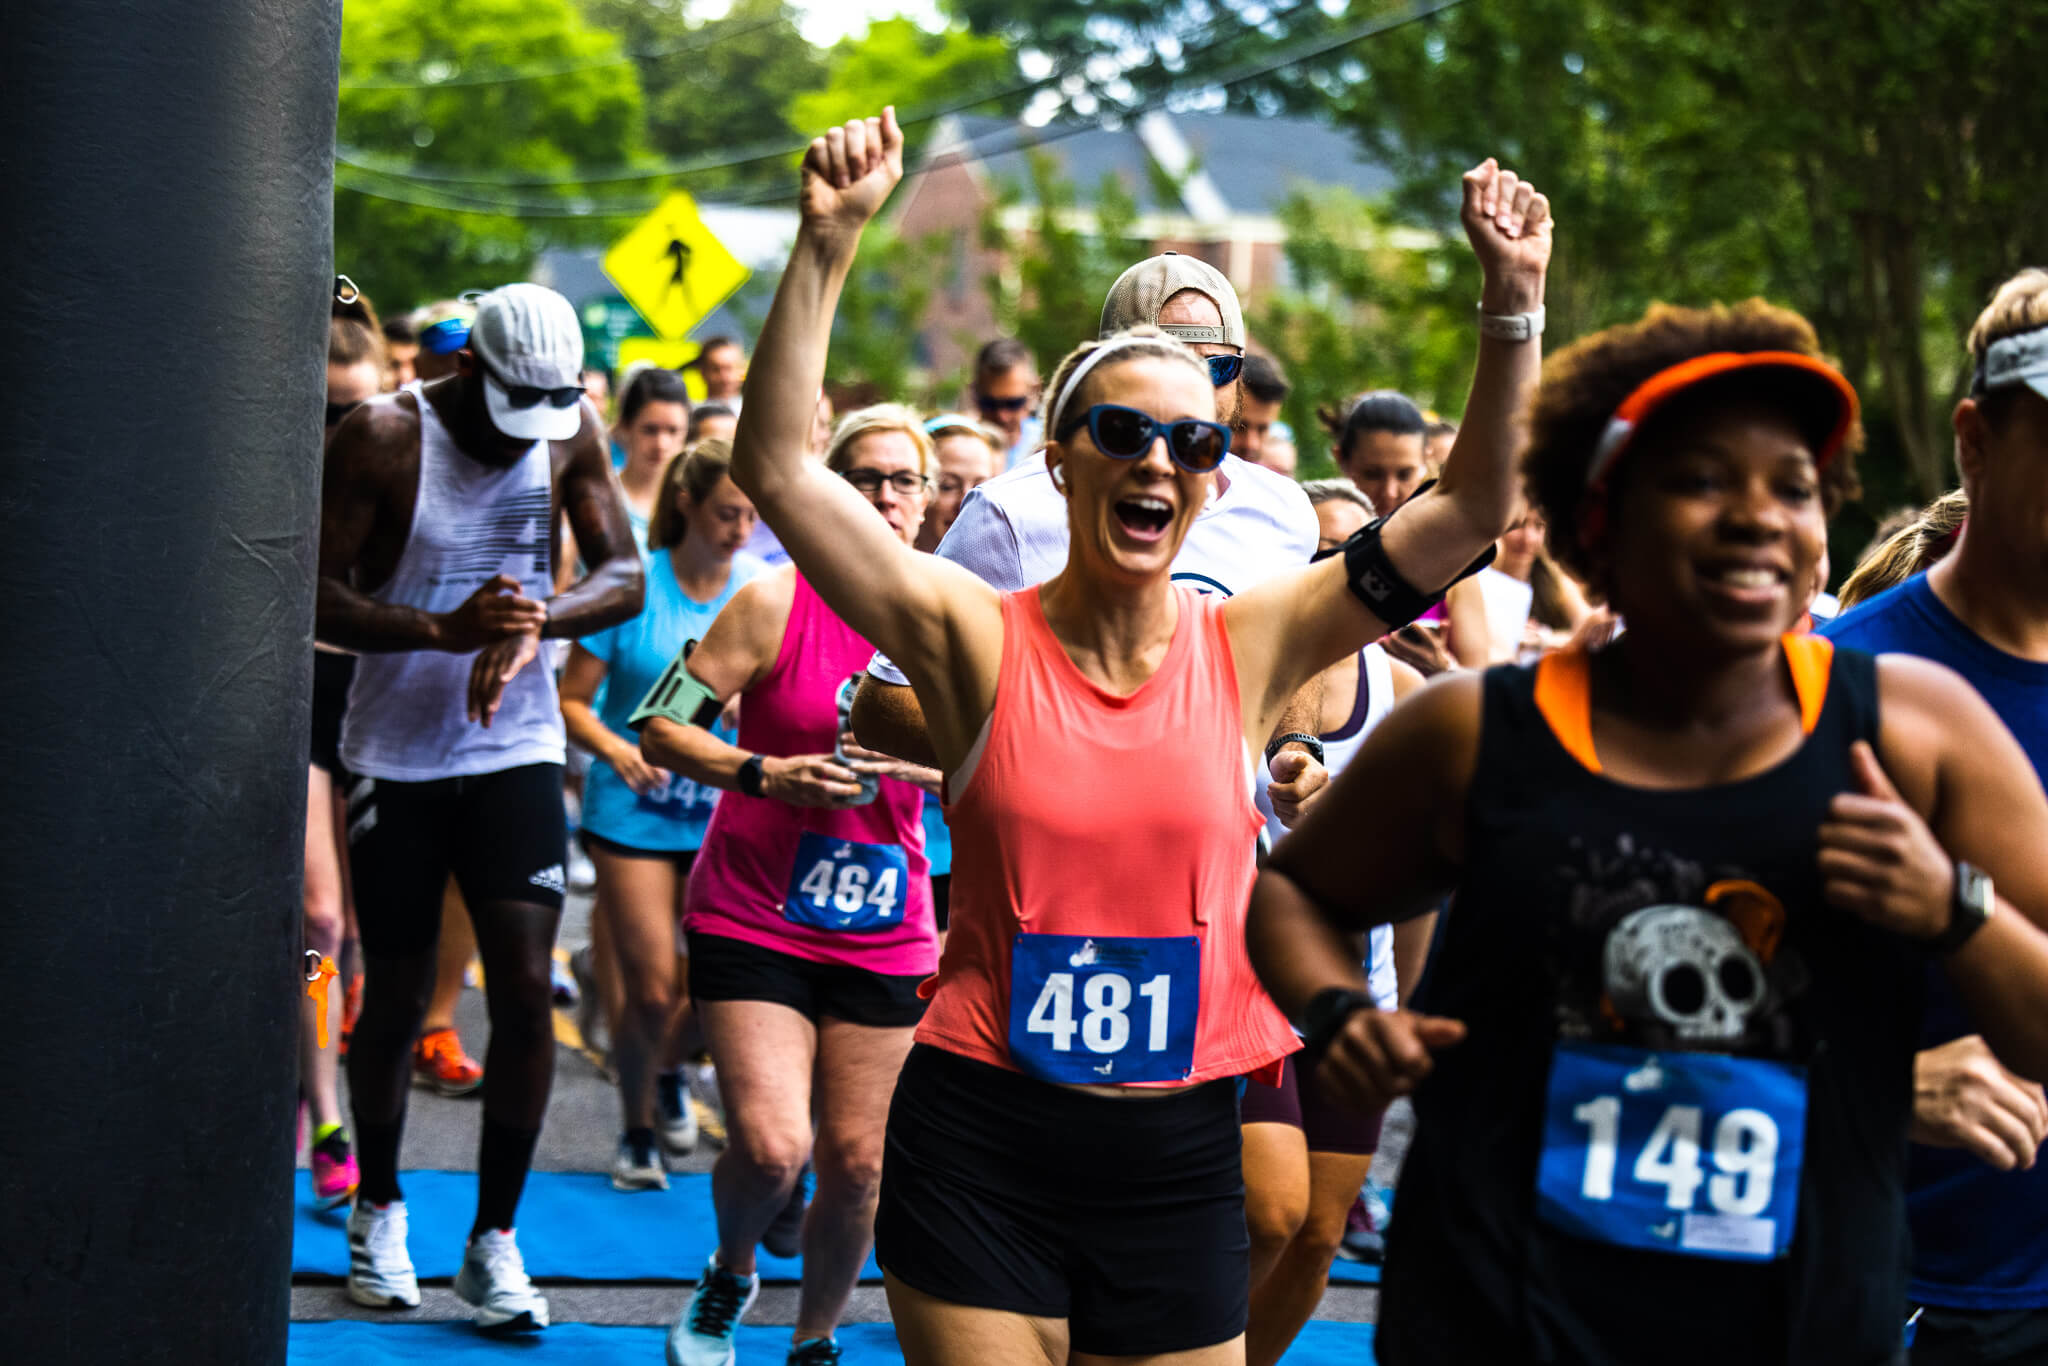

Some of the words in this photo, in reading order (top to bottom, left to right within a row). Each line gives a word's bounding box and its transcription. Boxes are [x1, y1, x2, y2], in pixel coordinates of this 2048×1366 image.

[800, 859, 898, 917] 464
[1027, 973, 1170, 1053] 481
[1574, 1096, 1779, 1216] 149
